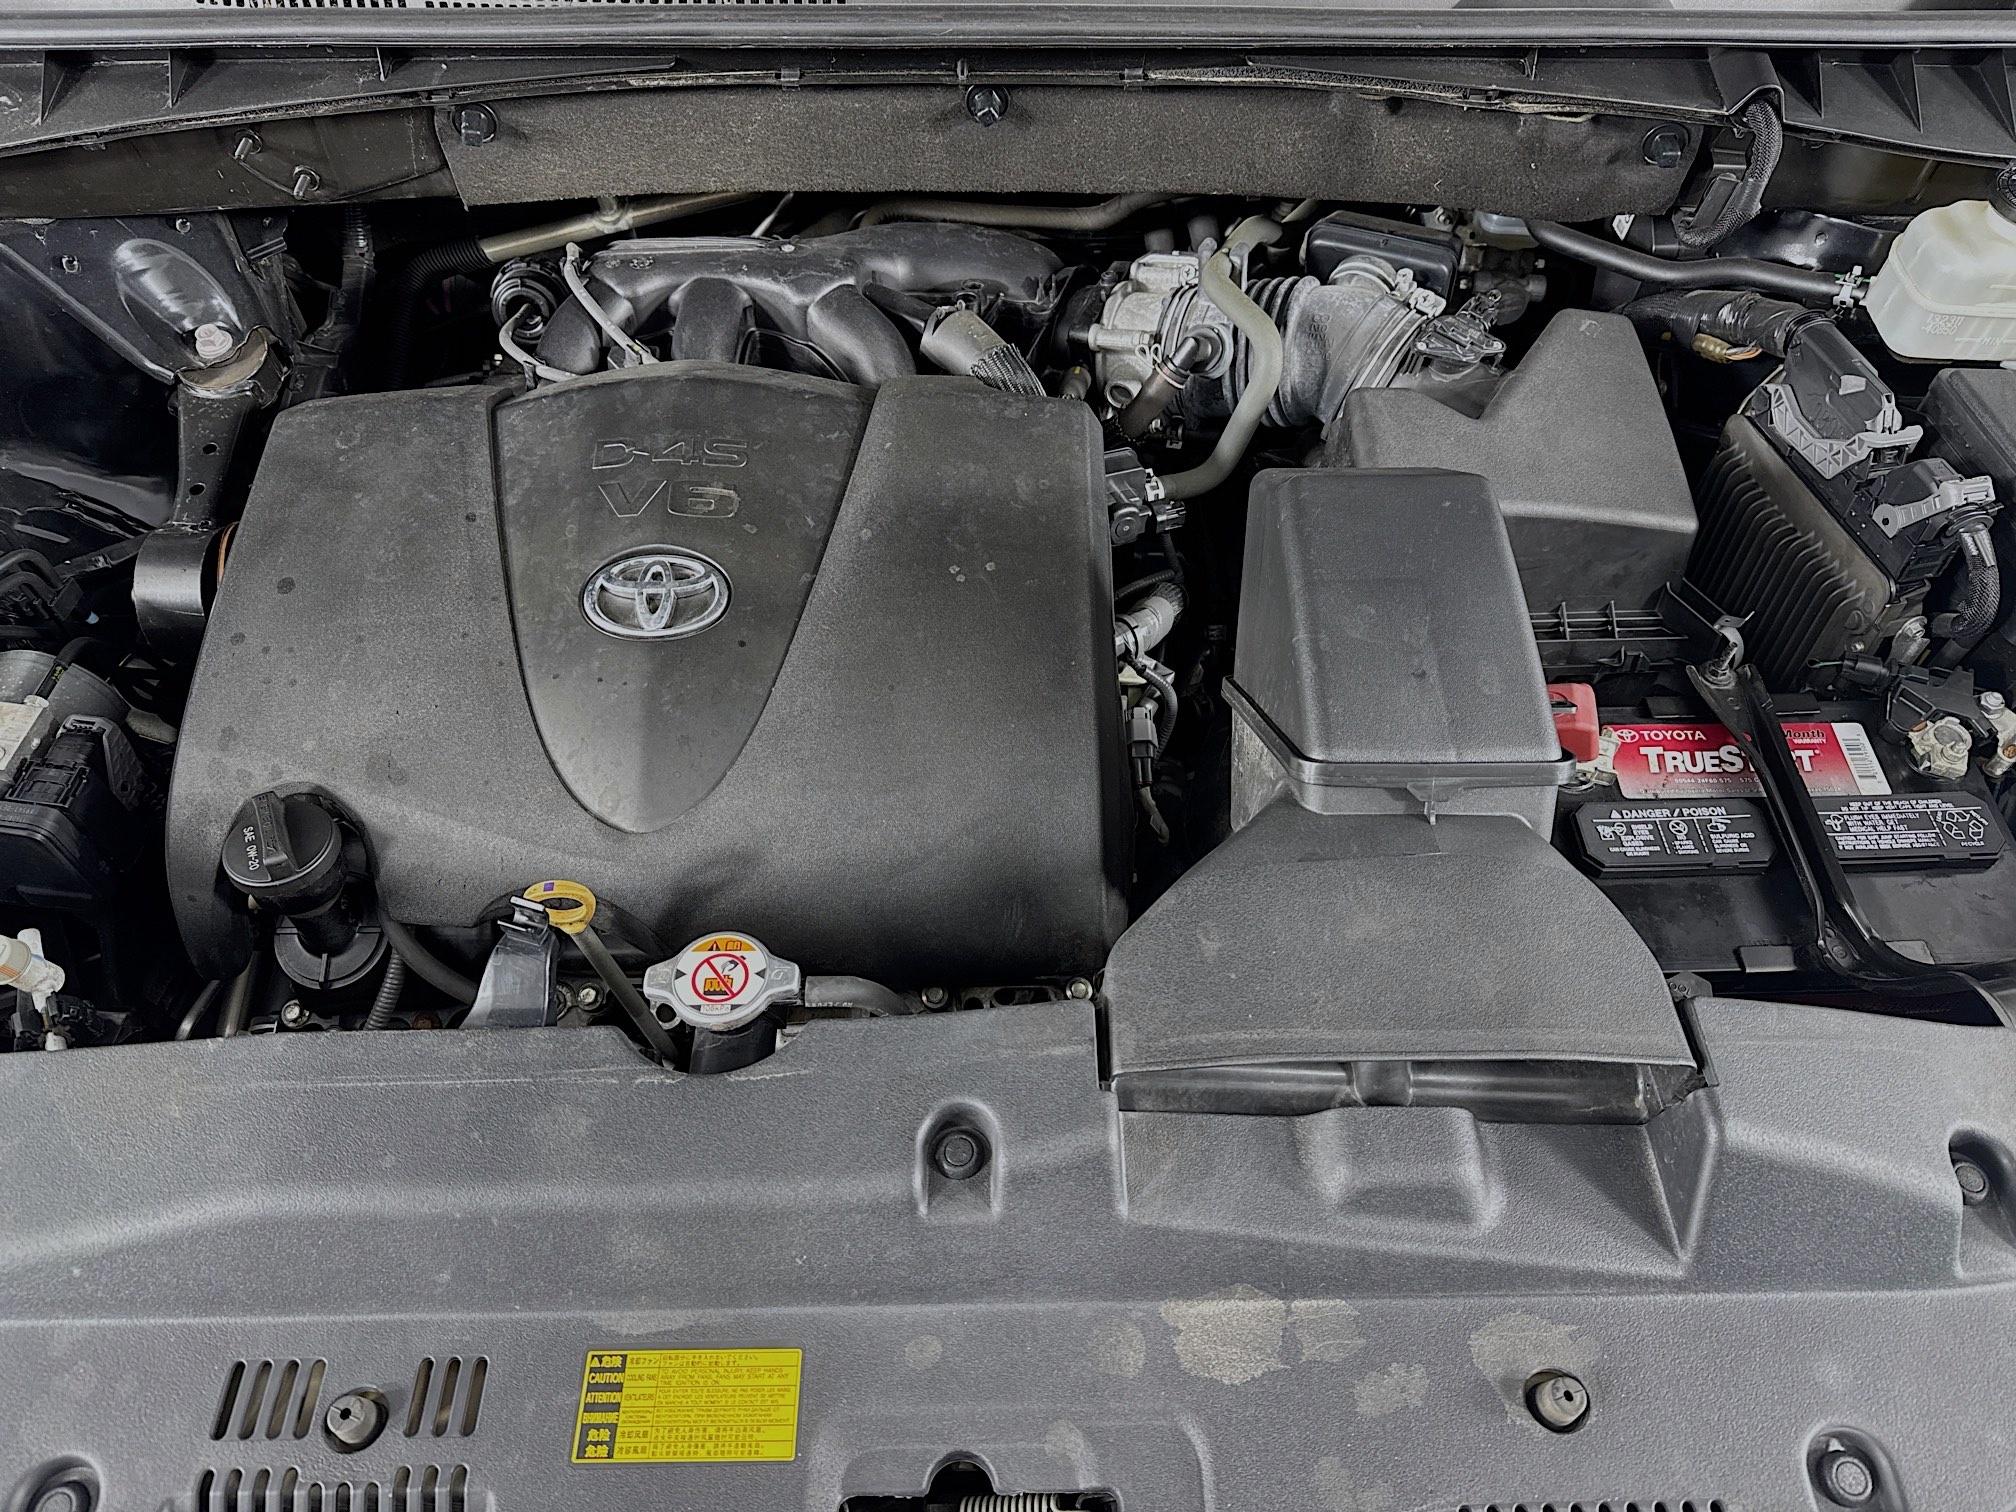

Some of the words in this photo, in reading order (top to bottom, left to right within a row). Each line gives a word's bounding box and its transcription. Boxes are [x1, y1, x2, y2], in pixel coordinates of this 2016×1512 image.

[592, 437, 748, 470] D-4S
[598, 480, 741, 518] V6
[1640, 730, 1707, 741] TOYOTA
[1622, 809, 1671, 818] DANGER
[1672, 808, 1680, 817] /
[1682, 807, 1727, 817] POISON
[1881, 812, 1920, 820] IMMEDIATELY
[243, 826, 256, 843] SAE
[246, 844, 260, 871] 0W-20
[588, 1372, 625, 1384] CAUTION
[585, 1392, 622, 1403] ATTENTION
